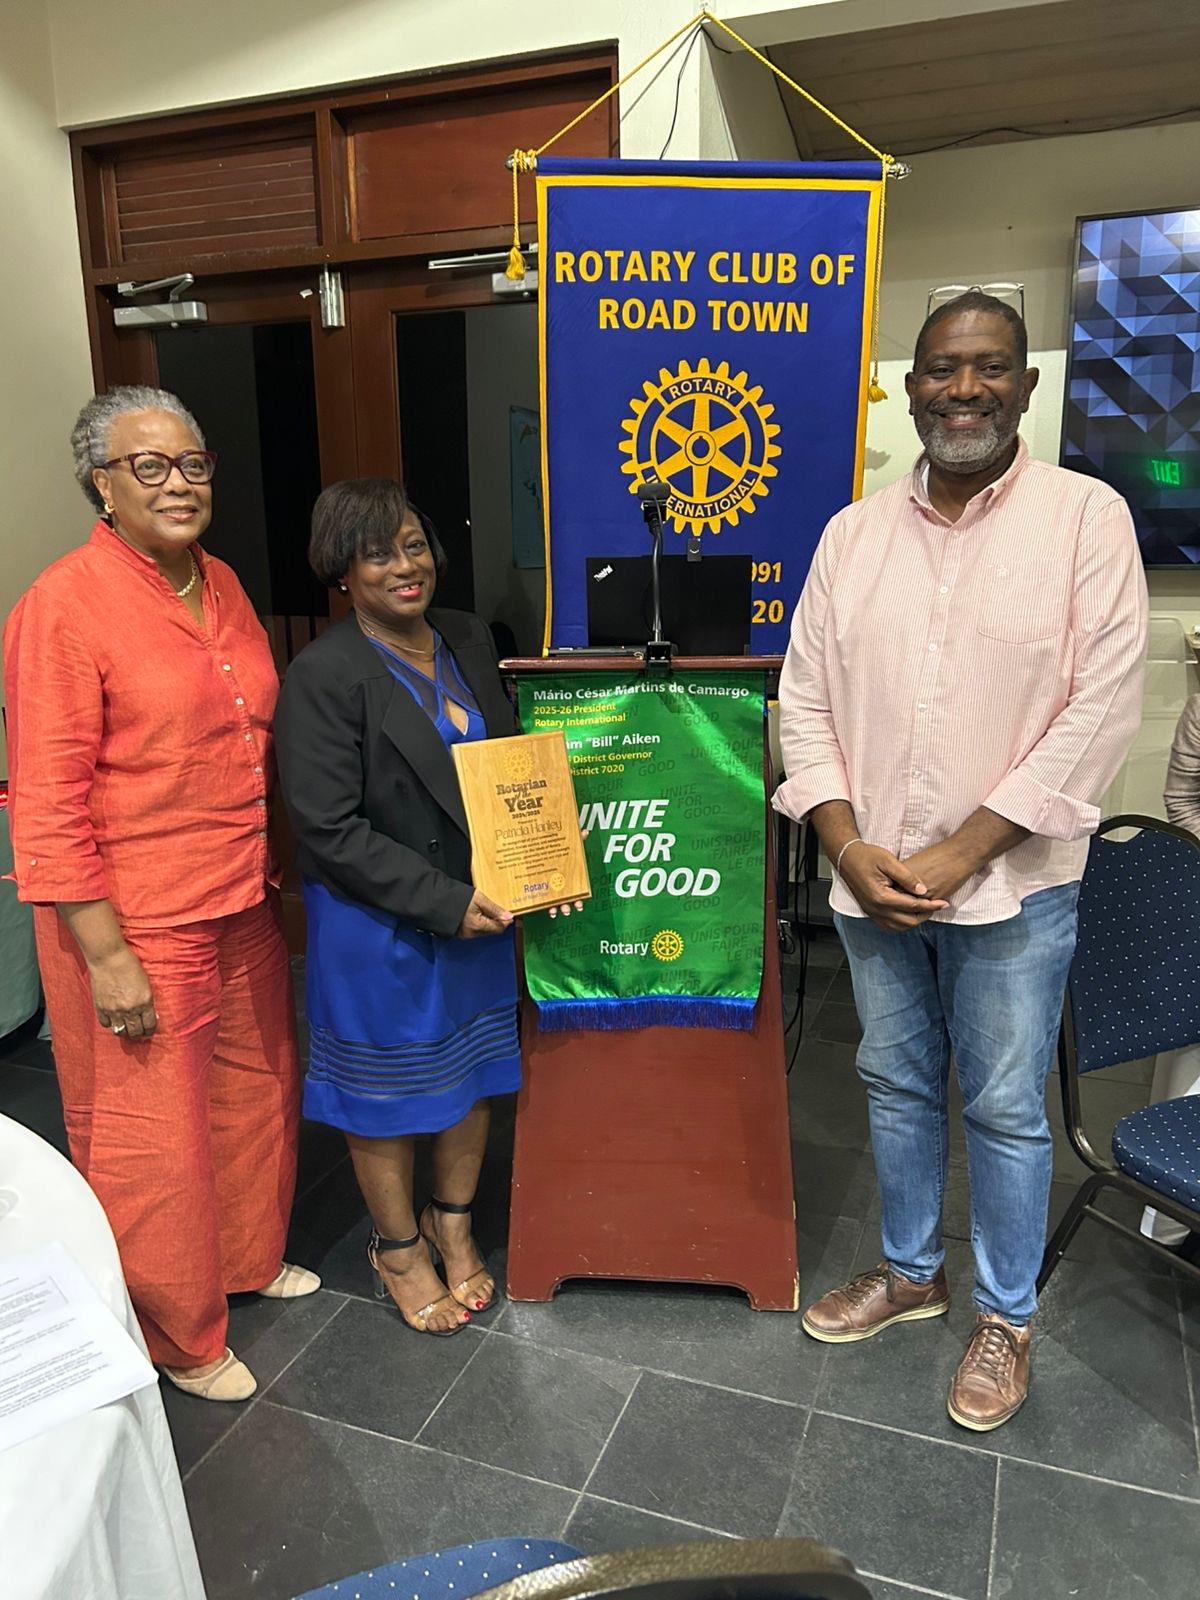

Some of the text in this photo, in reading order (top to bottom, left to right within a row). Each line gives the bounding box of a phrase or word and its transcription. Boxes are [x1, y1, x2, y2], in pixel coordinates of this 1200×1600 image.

[555, 250, 855, 285] ROTARY CLUB OF
[599, 298, 809, 333] ROAD TOWN
[669, 378, 737, 400] ROTARY
[646, 474, 757, 518] IERNATIONAL
[533, 682, 750, 701] Mário César Martins de Camargo
[534, 706, 572, 716] 2025-26
[573, 702, 616, 714] President
[534, 713, 626, 729] Rotary International
[621, 733, 661, 746] Aiken
[572, 753, 607, 764] District
[608, 751, 653, 762] Governor
[570, 764, 625, 777] istrict 7020
[496, 779, 548, 795] Rotarian
[504, 796, 544, 813] Year
[603, 833, 676, 863] FOR
[523, 881, 550, 894] Rotary
[614, 867, 721, 898] GOOD
[600, 940, 649, 957] Rotary
